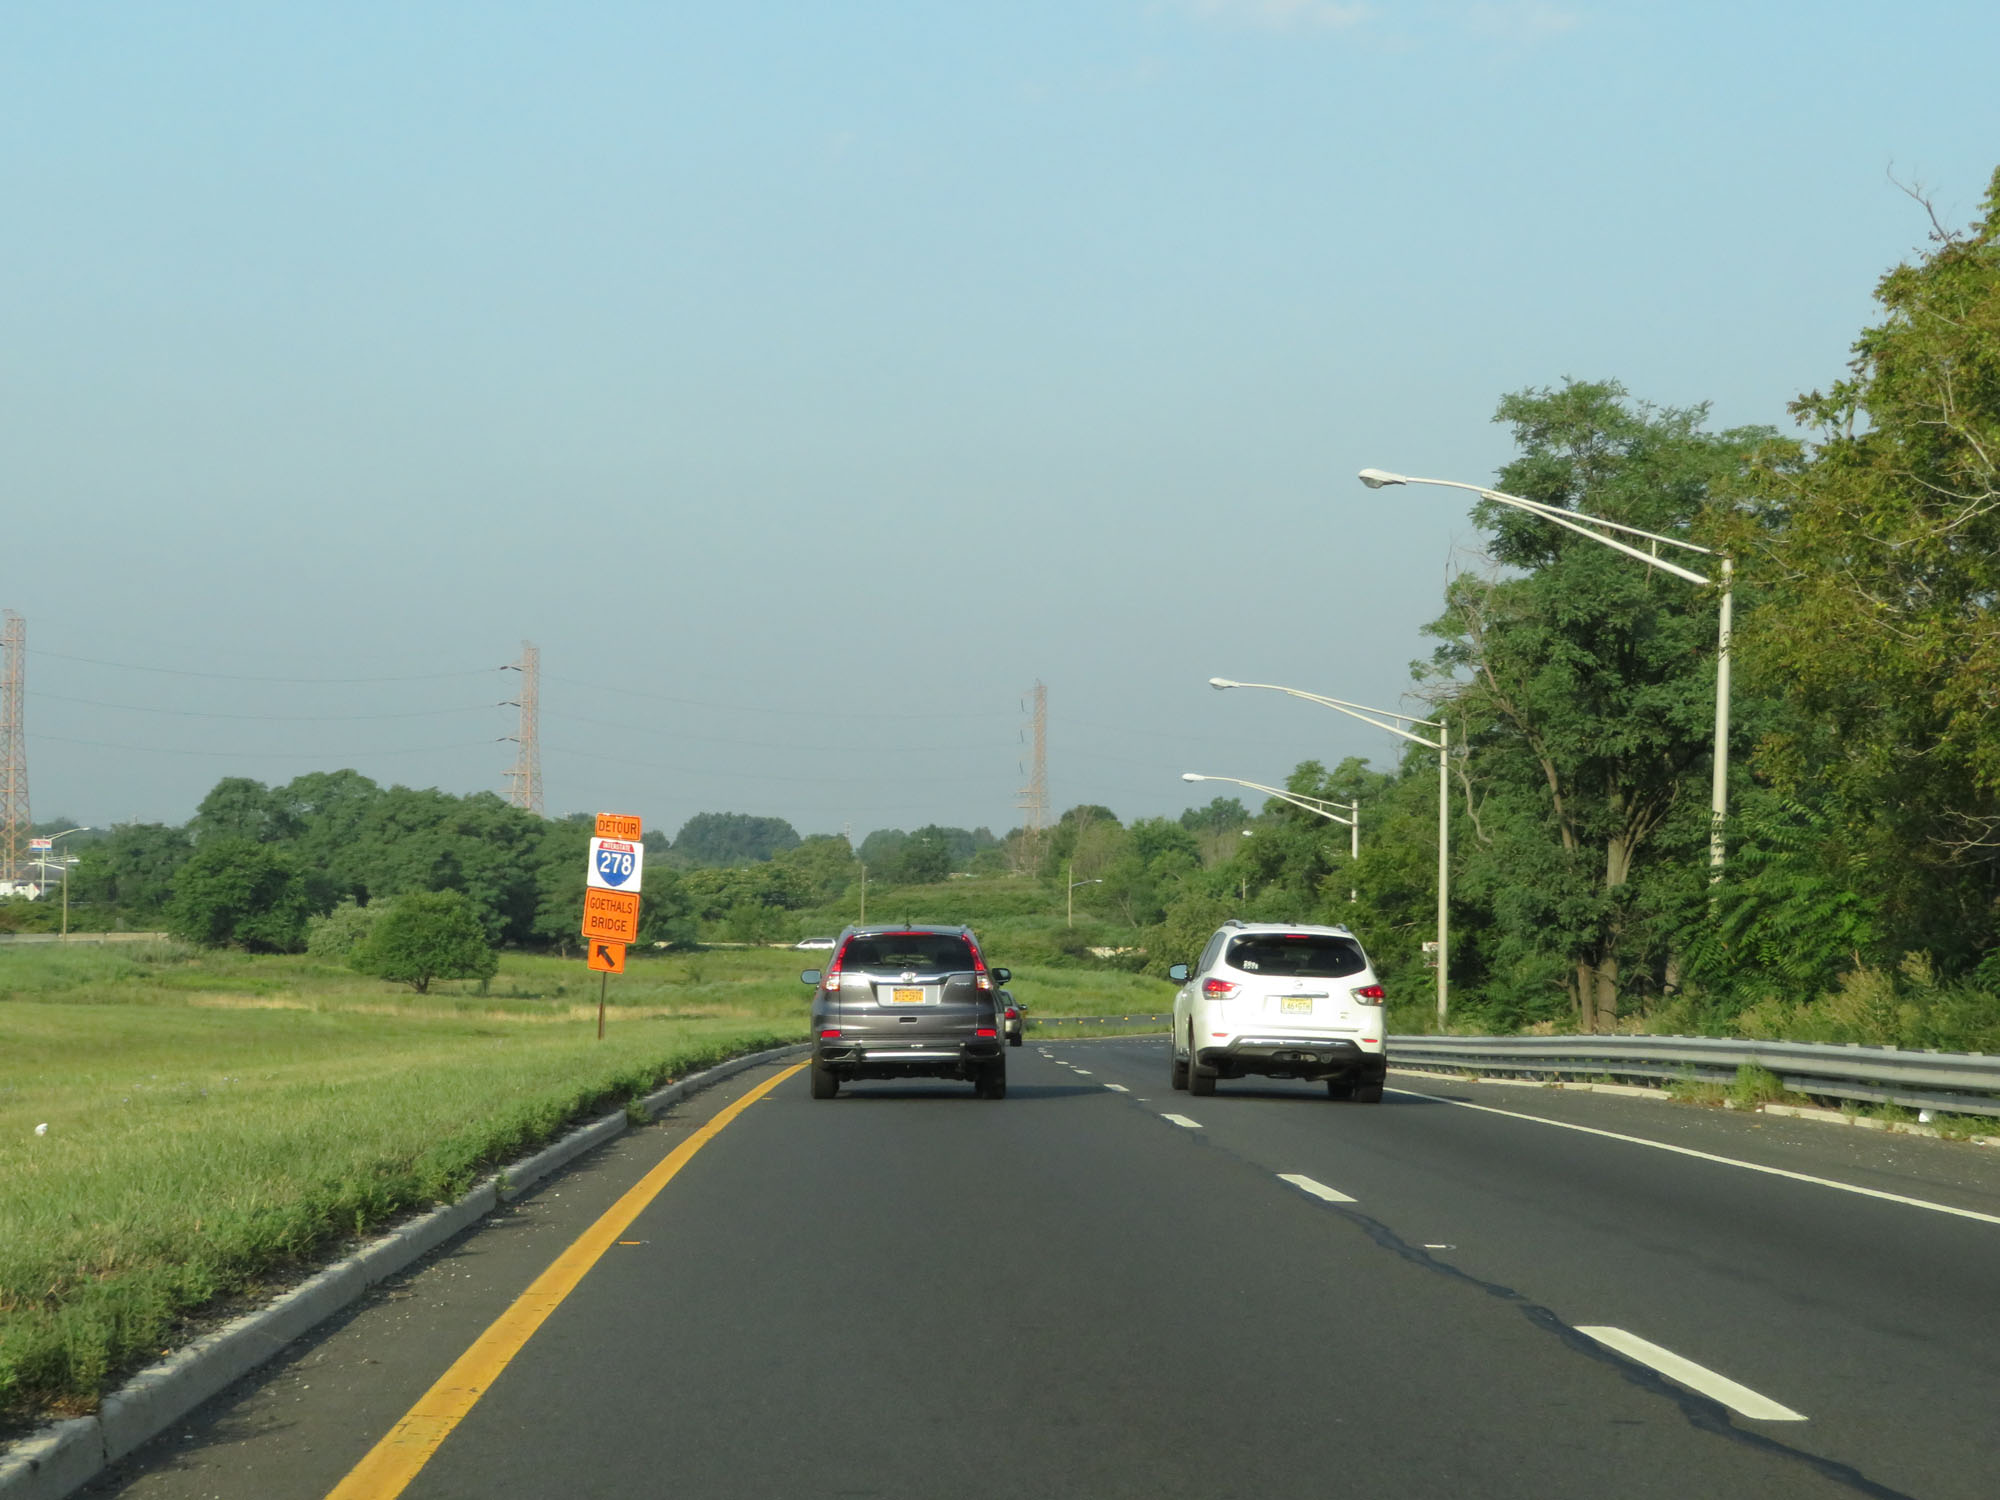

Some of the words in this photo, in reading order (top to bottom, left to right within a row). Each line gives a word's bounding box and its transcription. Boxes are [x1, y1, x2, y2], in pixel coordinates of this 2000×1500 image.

[599, 820, 637, 834] DETOUR
[600, 852, 632, 875] 278
[590, 897, 632, 914] GOETHALS
[591, 916, 627, 932] BRIDGE
